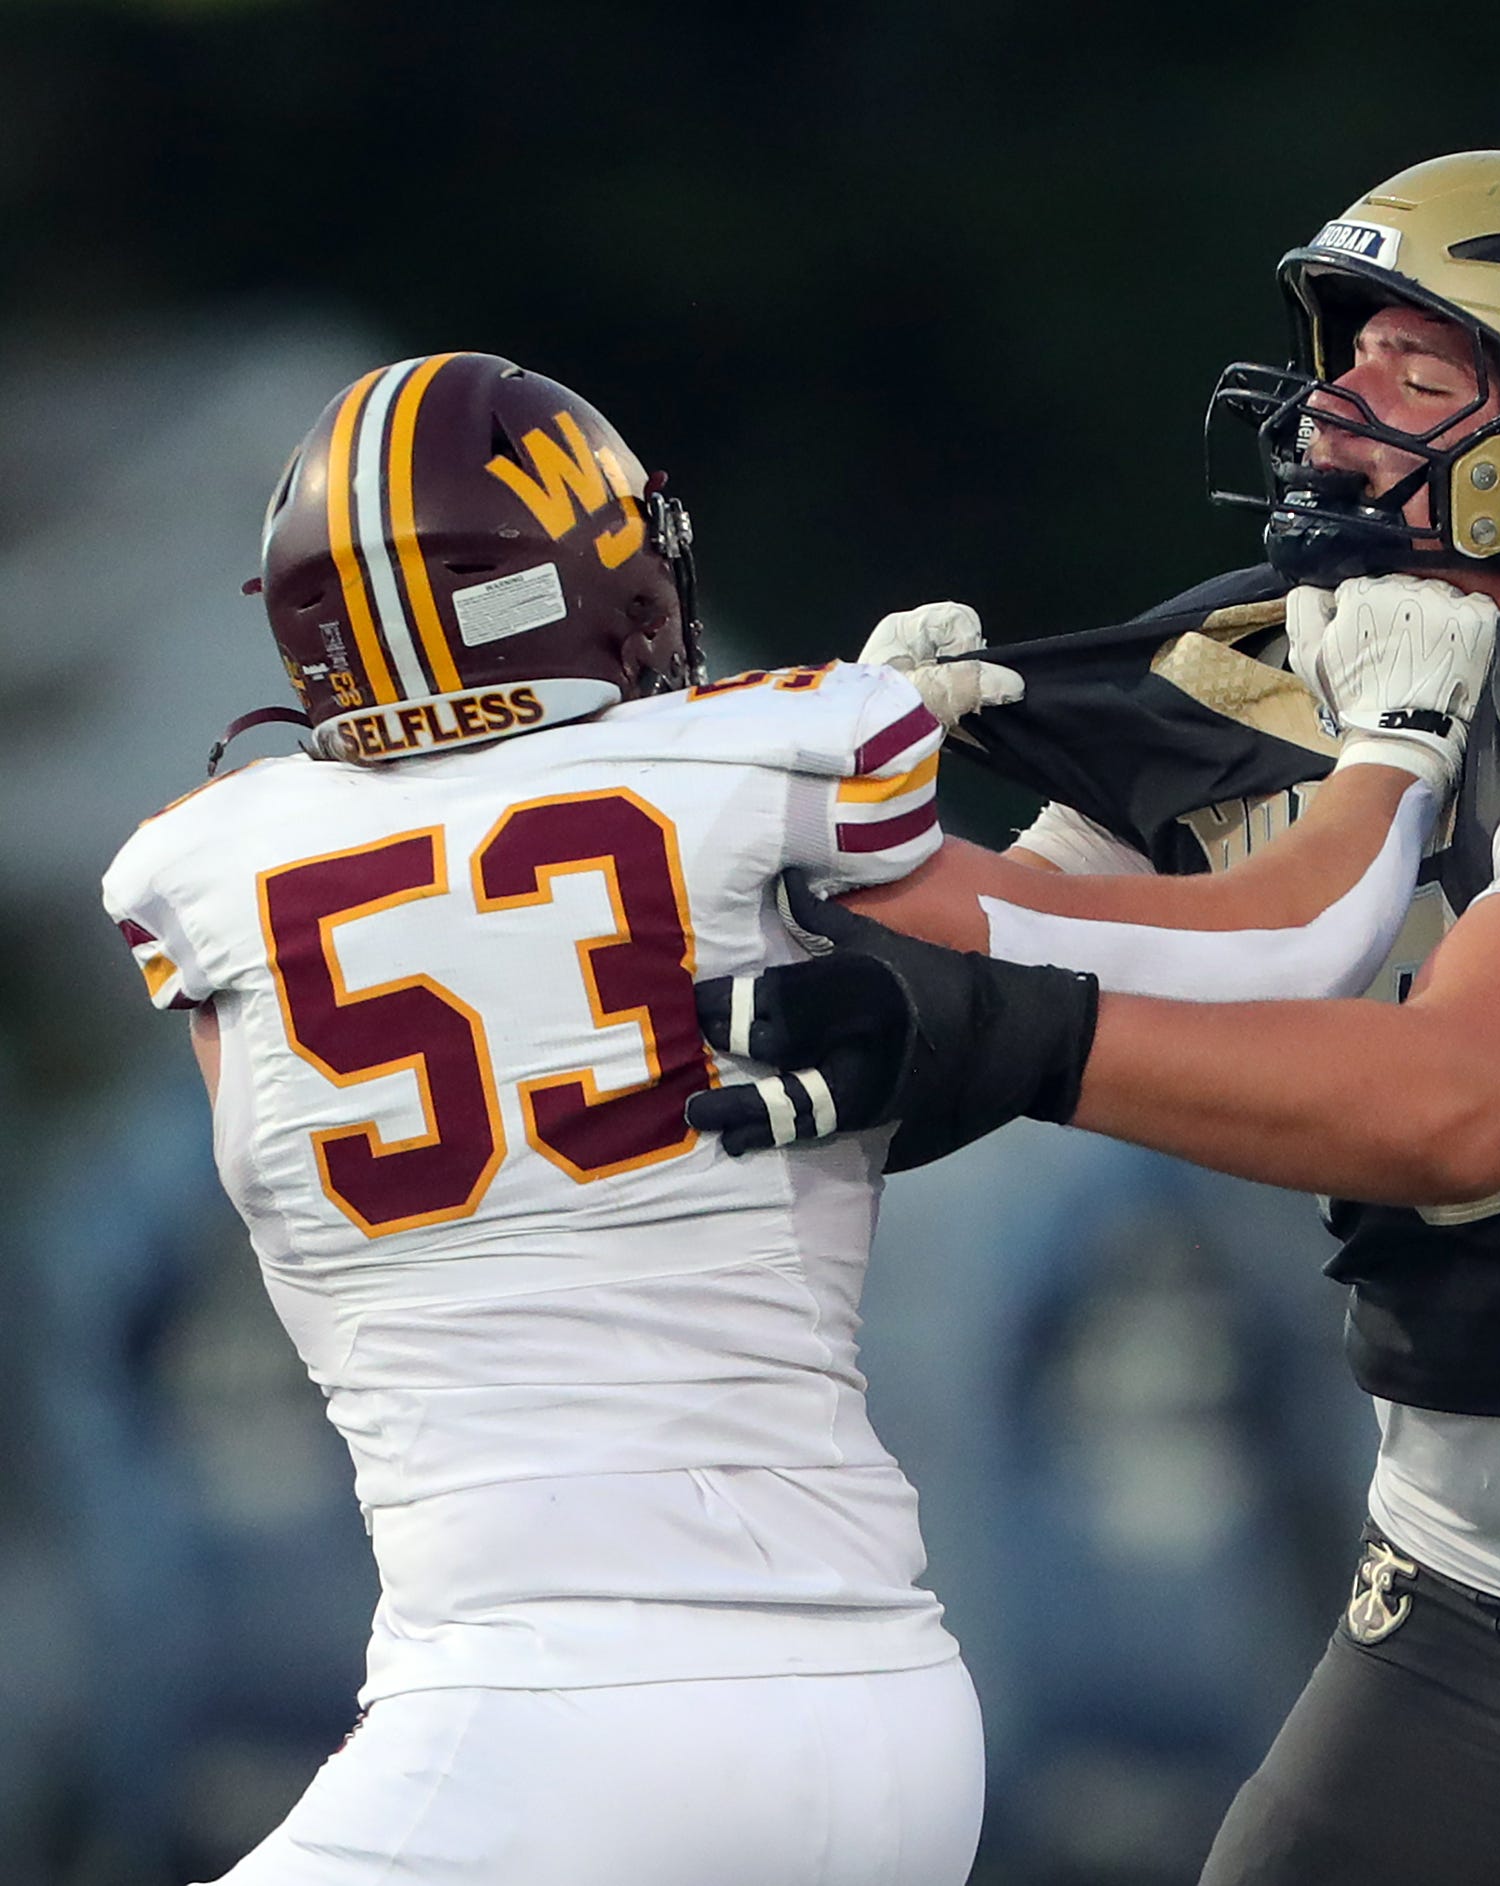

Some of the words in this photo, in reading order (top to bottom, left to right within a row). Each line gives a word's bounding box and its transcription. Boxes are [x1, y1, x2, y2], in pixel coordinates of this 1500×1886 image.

[484, 410, 647, 570] WJ
[329, 671, 364, 708] 53
[336, 686, 545, 757] SELFLESS
[255, 786, 722, 1240] 53
